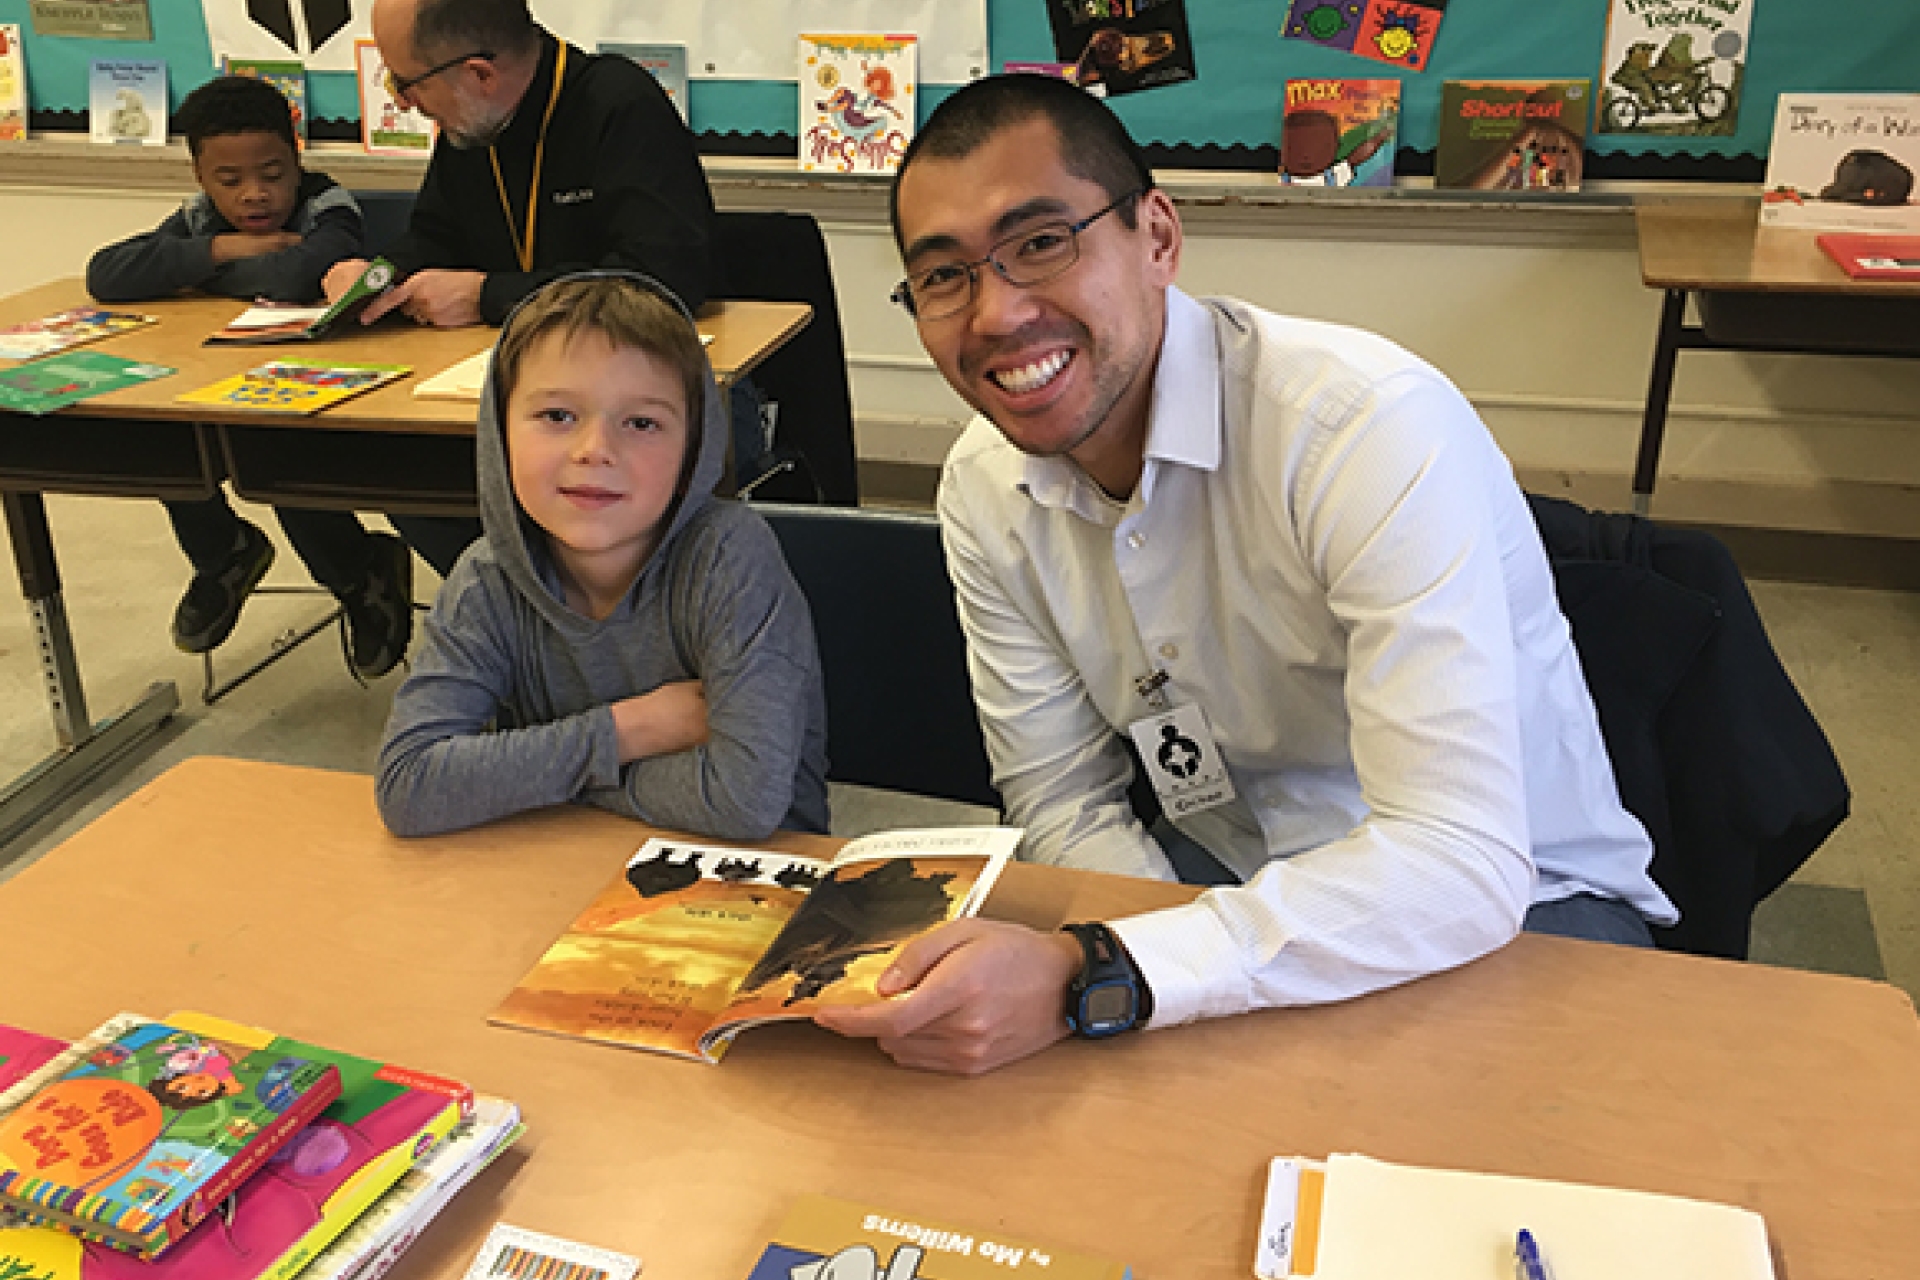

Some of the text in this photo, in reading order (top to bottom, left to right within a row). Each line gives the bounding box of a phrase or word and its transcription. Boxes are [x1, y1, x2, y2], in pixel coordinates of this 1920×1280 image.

[1642, 7, 1723, 32] Together
[862, 1214, 974, 1256] Willems
[978, 1240, 1025, 1269] Mo
